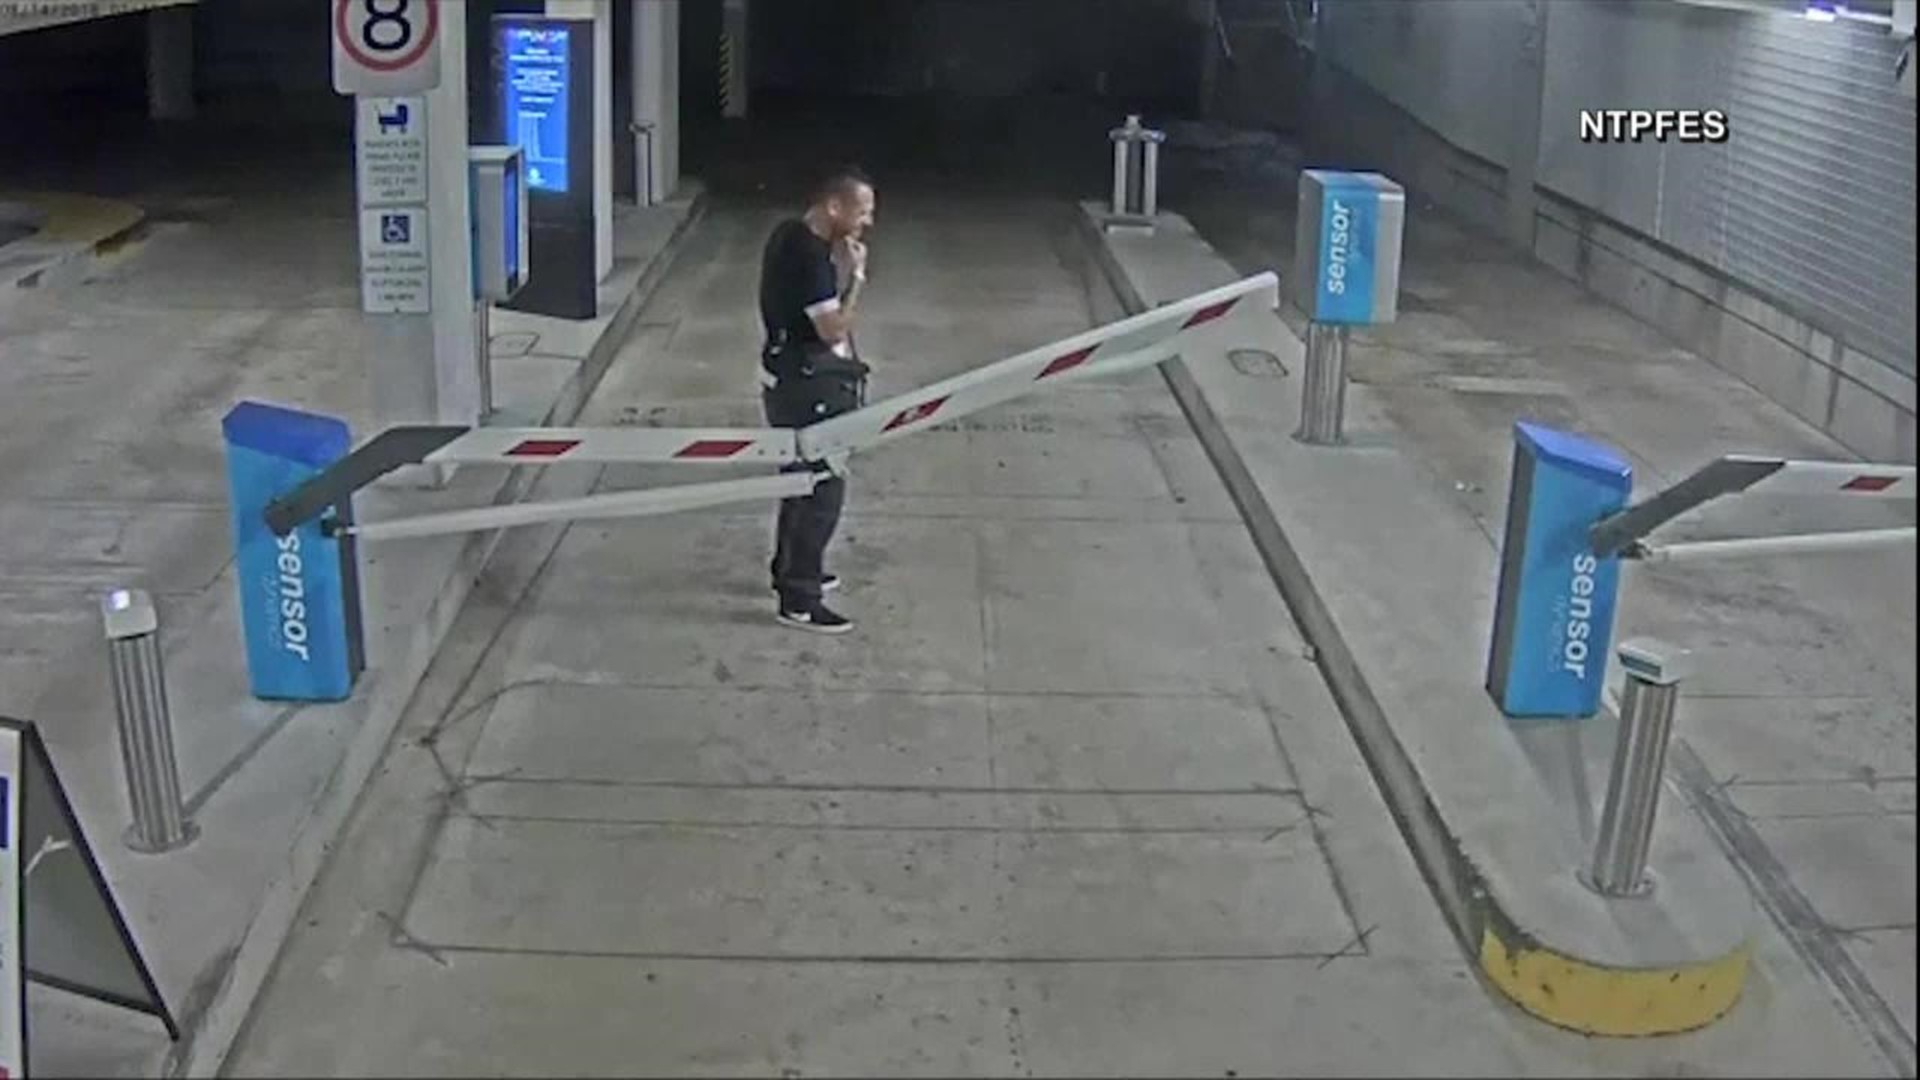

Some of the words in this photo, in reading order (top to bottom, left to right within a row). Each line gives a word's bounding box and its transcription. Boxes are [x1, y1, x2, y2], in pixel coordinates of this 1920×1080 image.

[363, 0, 411, 50] 8
[1326, 199, 1350, 295] sensor
[276, 527, 310, 662] sensor
[1563, 553, 1598, 679] sensor
